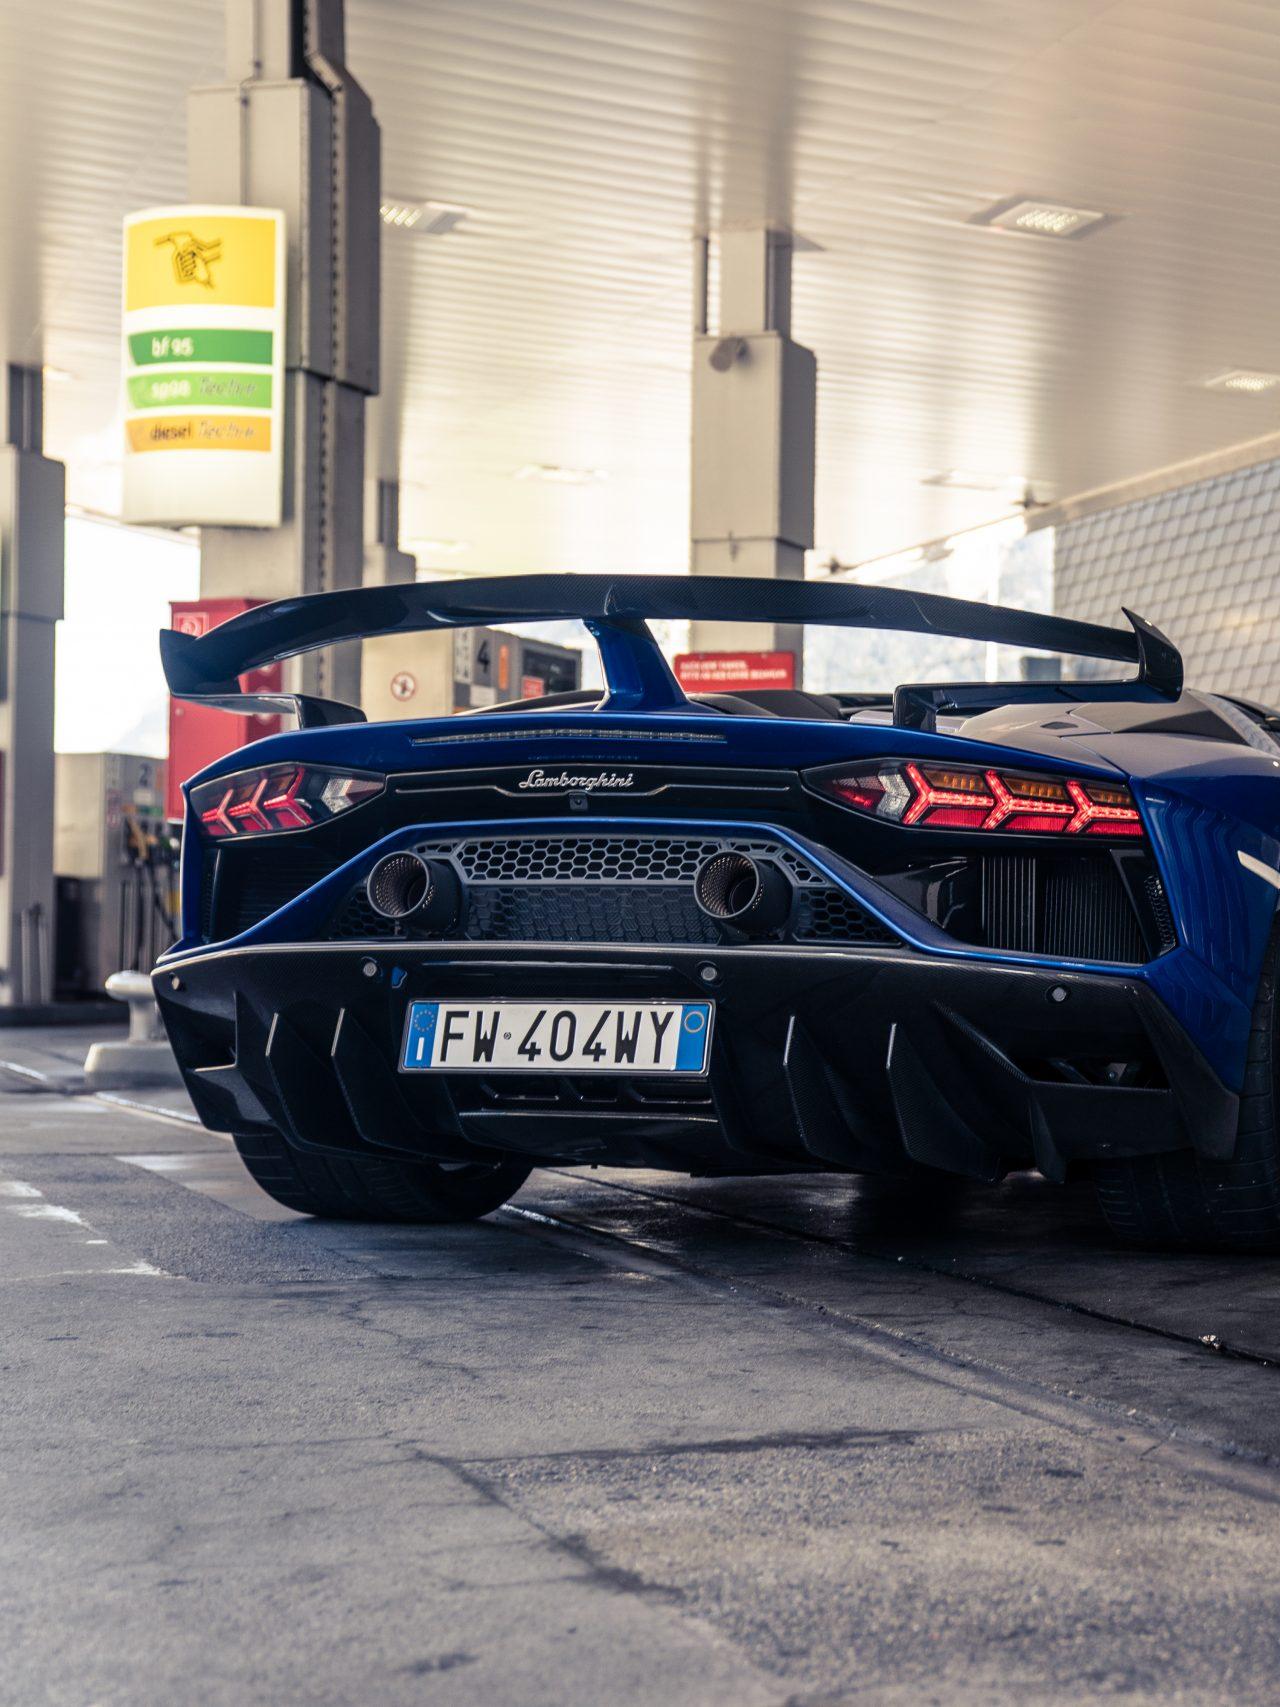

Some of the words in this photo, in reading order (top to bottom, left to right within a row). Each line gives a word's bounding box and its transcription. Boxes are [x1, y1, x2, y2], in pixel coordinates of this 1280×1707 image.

[477, 640, 490, 673] 4
[518, 769, 634, 791] Lamborghini
[440, 1010, 500, 1063] FW
[517, 1010, 674, 1064] 404WY
